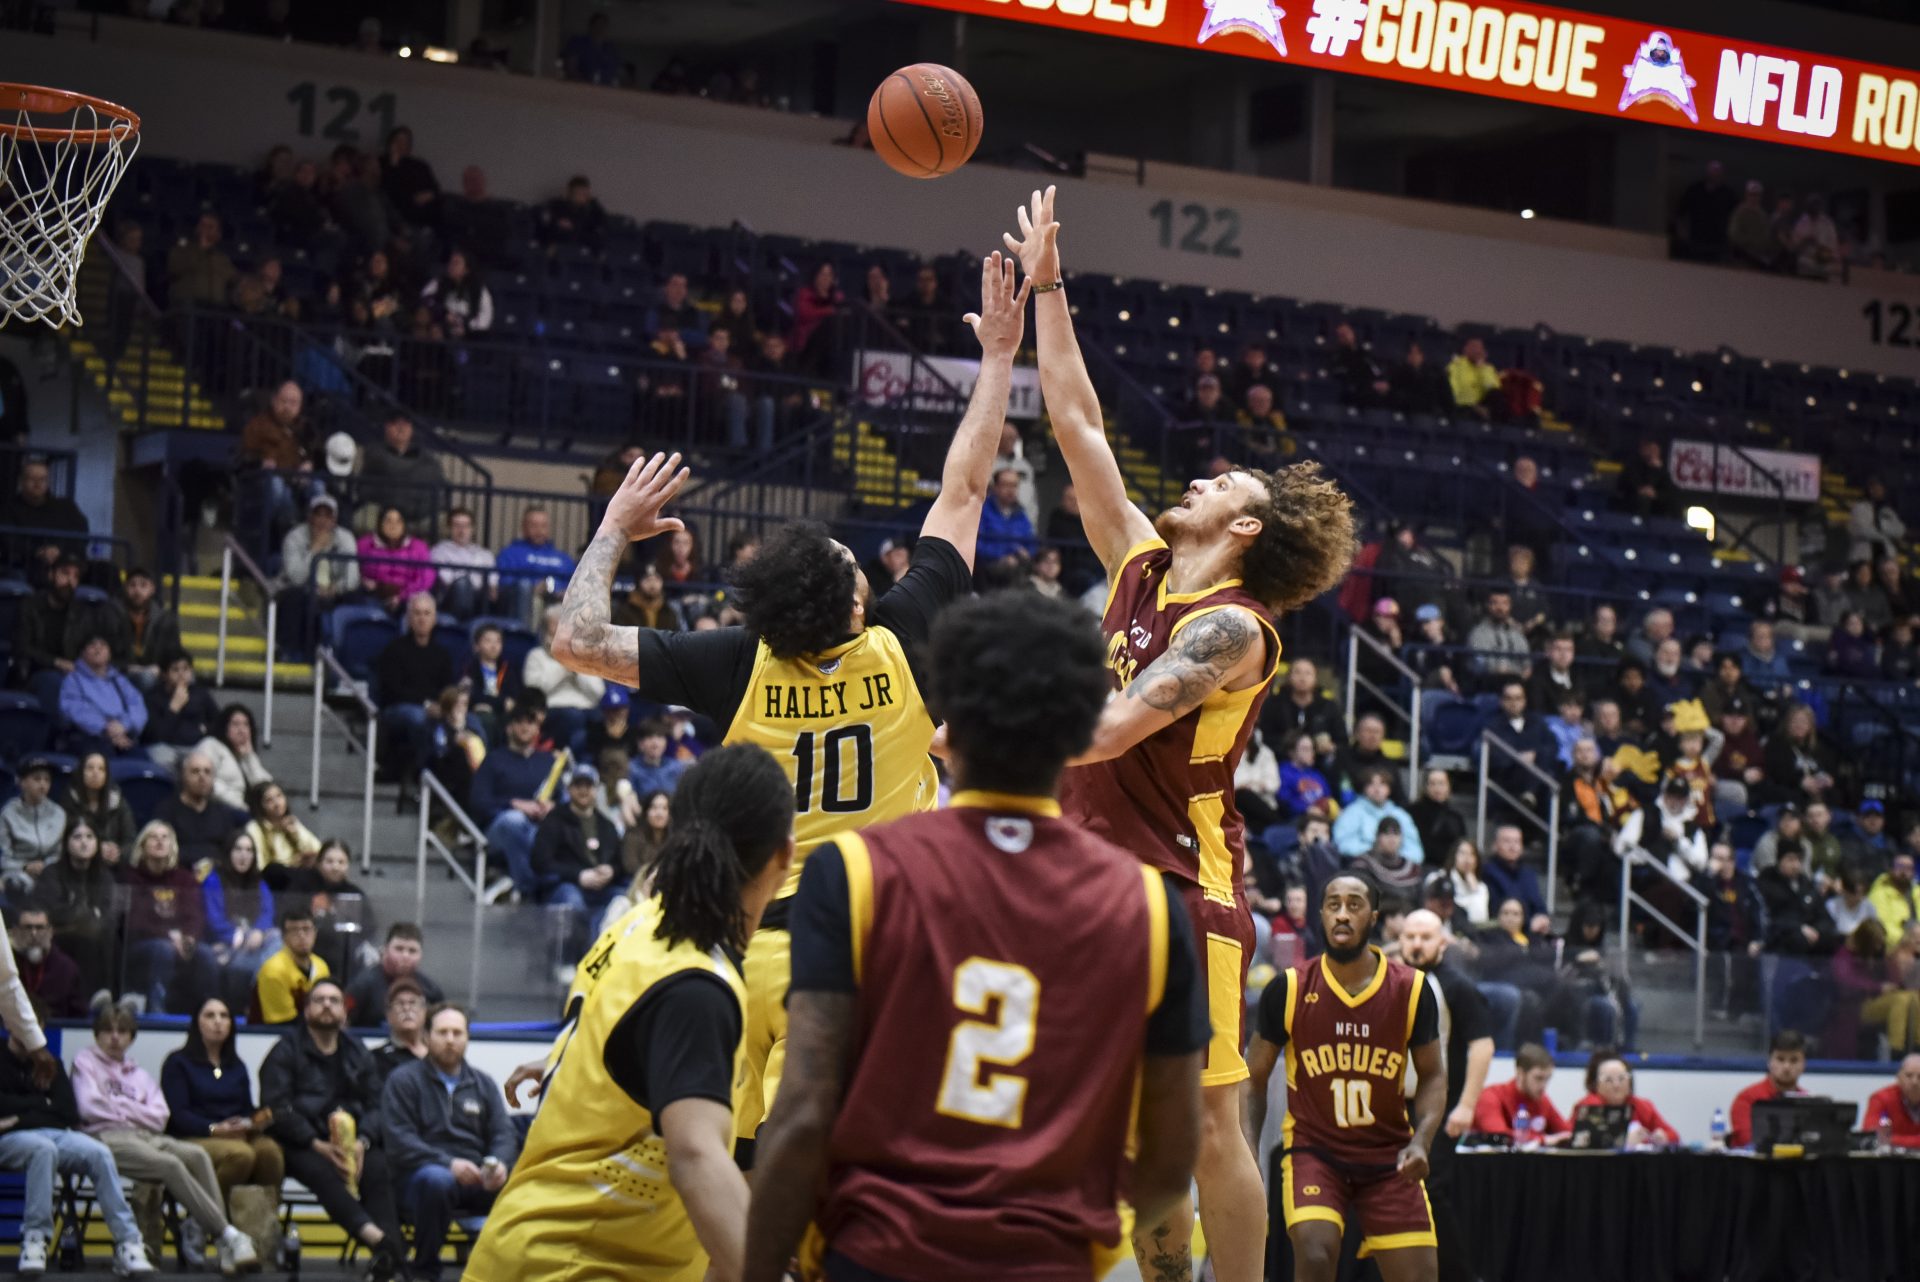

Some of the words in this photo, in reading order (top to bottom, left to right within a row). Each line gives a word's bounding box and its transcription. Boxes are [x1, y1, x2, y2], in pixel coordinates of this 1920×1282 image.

[1306, 0, 1605, 98] #GOROGUE
[287, 81, 397, 148] 121
[1713, 49, 1843, 137] NFLD
[1852, 72, 1920, 152] RO
[1150, 200, 1243, 258] 122
[1862, 299, 1920, 350] 12
[765, 681, 848, 719] HALEY
[859, 673, 894, 711] JR
[791, 723, 874, 815] 10
[935, 955, 1042, 1131] 2
[1335, 1021, 1370, 1038] NFLD
[1300, 1042, 1403, 1080] ROGUES
[1329, 1077, 1376, 1129] 10
